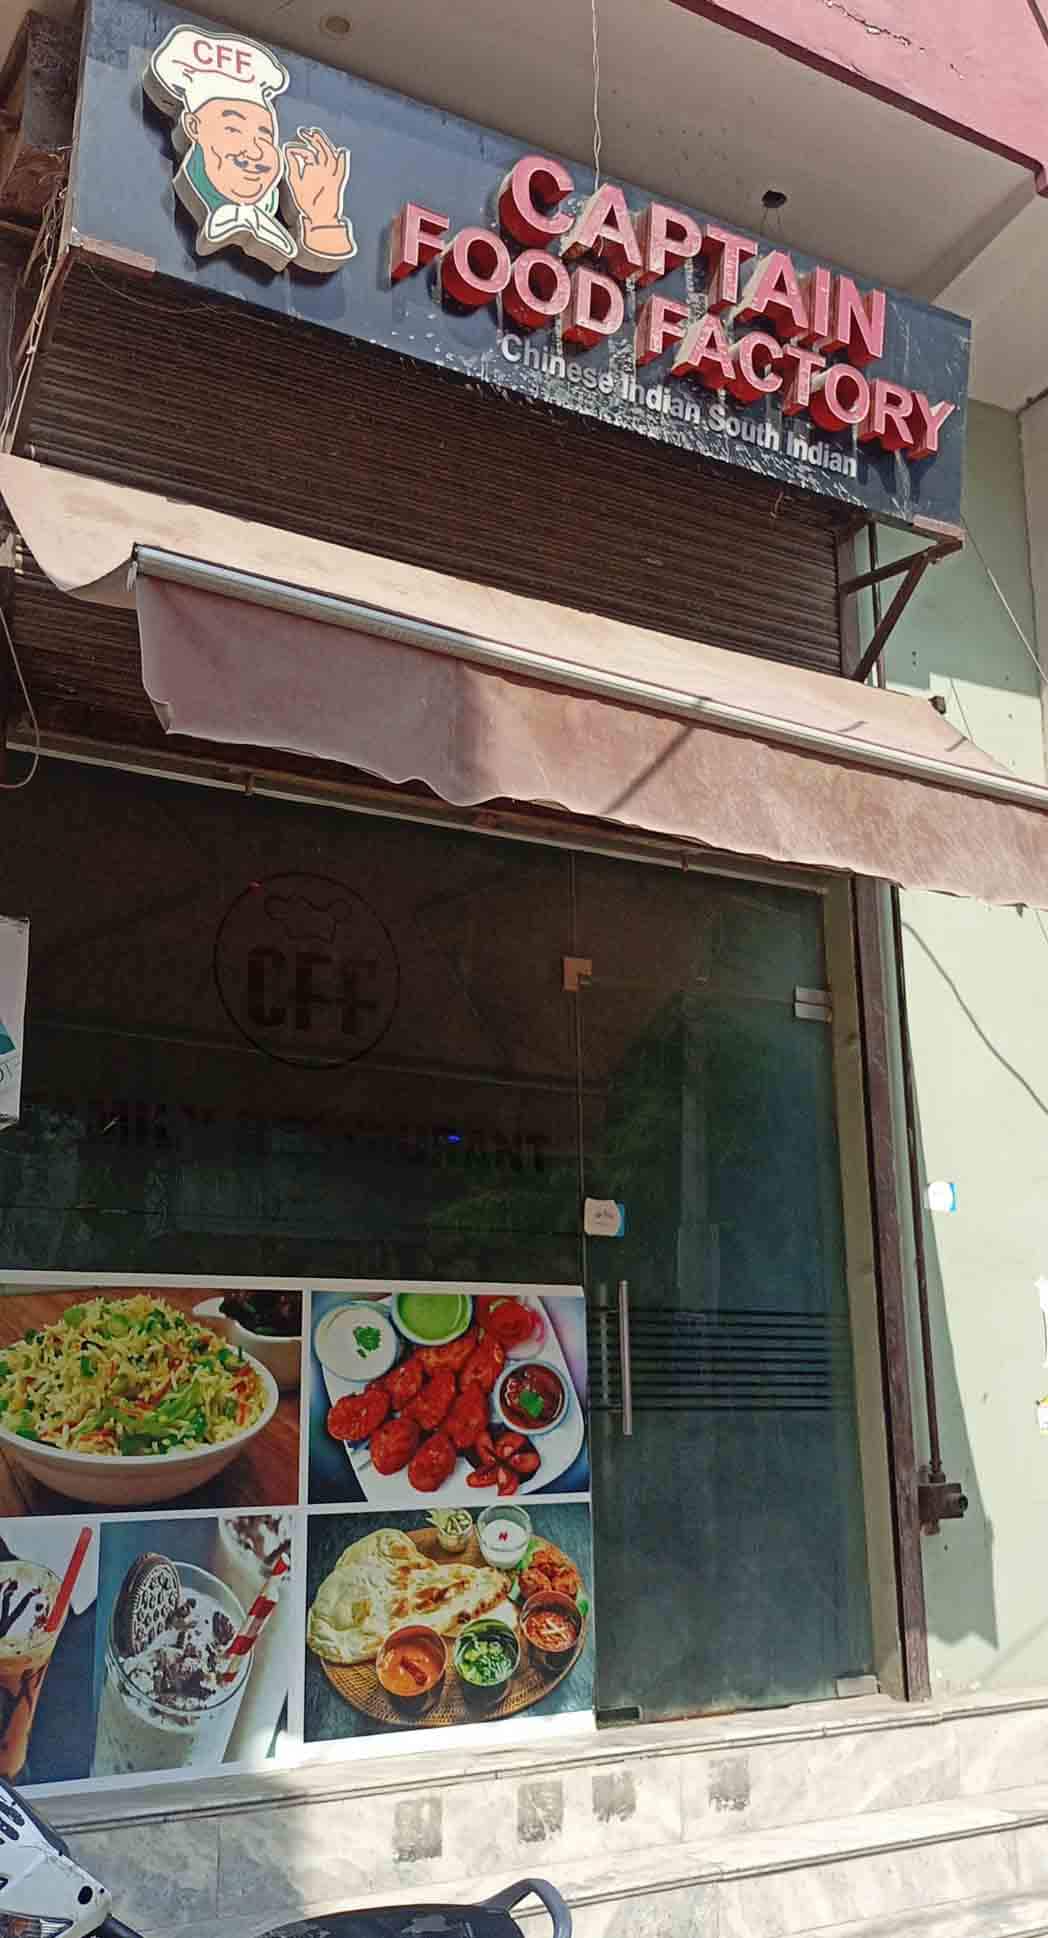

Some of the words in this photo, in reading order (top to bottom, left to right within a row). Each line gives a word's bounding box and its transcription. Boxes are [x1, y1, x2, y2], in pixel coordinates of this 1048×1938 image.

[192, 39, 253, 74] CFF
[395, 202, 626, 340] FOOD
[641, 294, 956, 455] FACTORY
[504, 154, 887, 363] CAPTAIN
[501, 333, 614, 394] Chinese
[622, 374, 700, 425] Indian
[708, 403, 780, 451] South
[787, 430, 857, 478] Indian
[248, 946, 377, 1034] CFF
